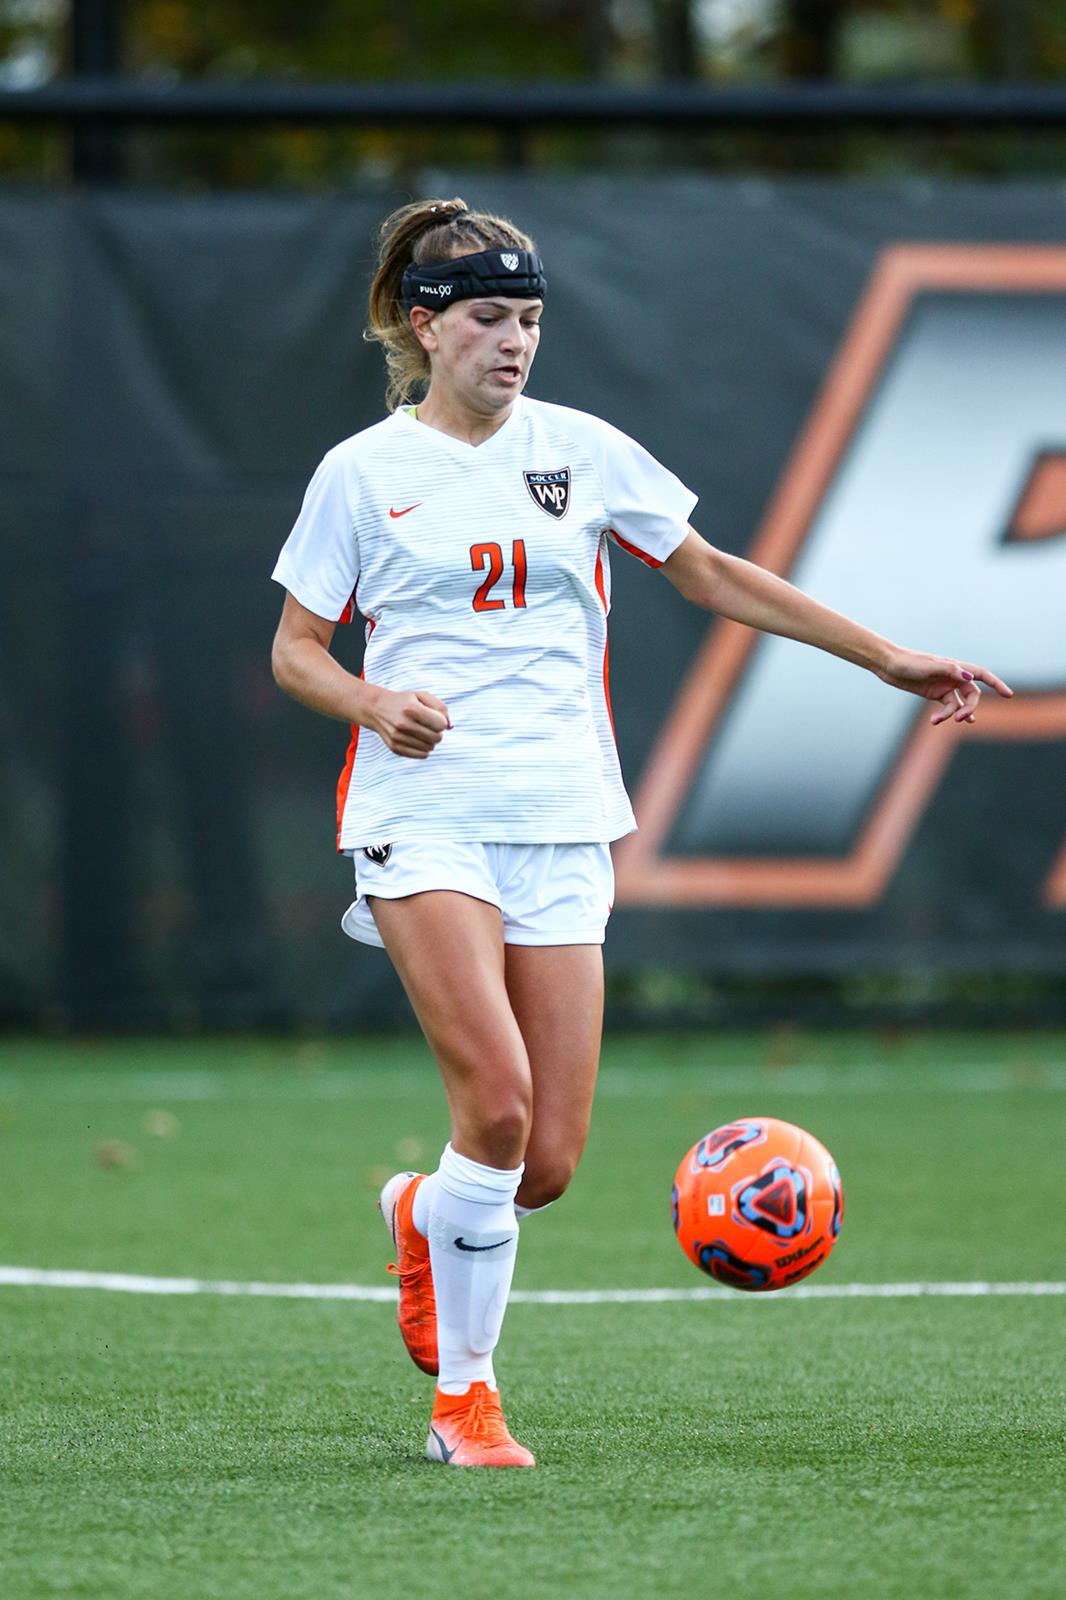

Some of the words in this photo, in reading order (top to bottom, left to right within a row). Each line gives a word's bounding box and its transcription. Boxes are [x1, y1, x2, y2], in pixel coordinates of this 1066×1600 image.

[530, 473, 567, 482] SOCCER
[533, 484, 566, 510] WP
[470, 539, 527, 613] 21
